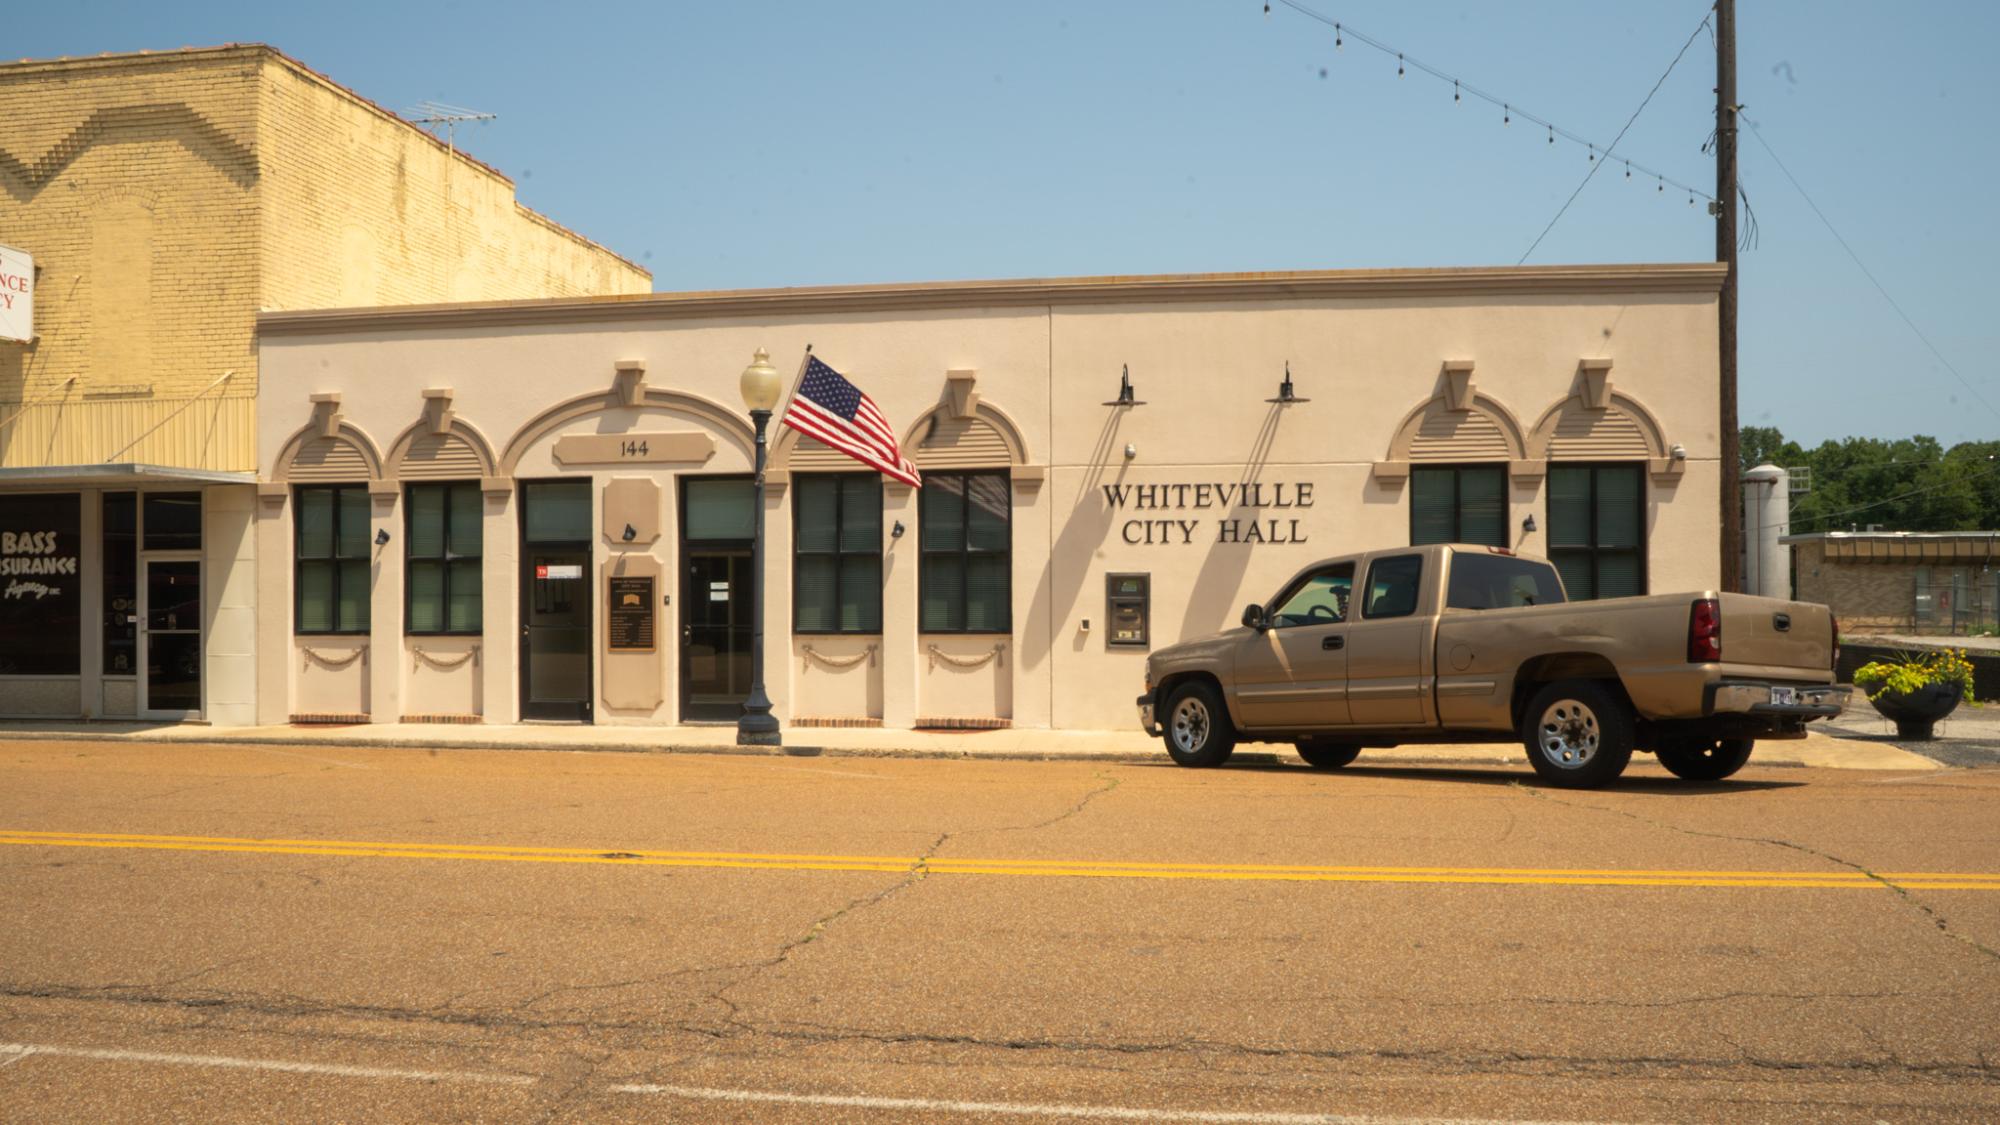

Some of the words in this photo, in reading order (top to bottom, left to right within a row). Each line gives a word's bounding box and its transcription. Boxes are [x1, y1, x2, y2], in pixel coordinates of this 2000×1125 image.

[0, 293, 14, 309] Y
[621, 440, 649, 457] 144
[1103, 483, 1314, 508] WHITEVILLE
[1122, 519, 1199, 545] CITY
[1218, 519, 1308, 544] HALL
[2, 531, 57, 554] BASS
[0, 557, 76, 576] SURANCE
[4, 579, 49, 599] Agency
